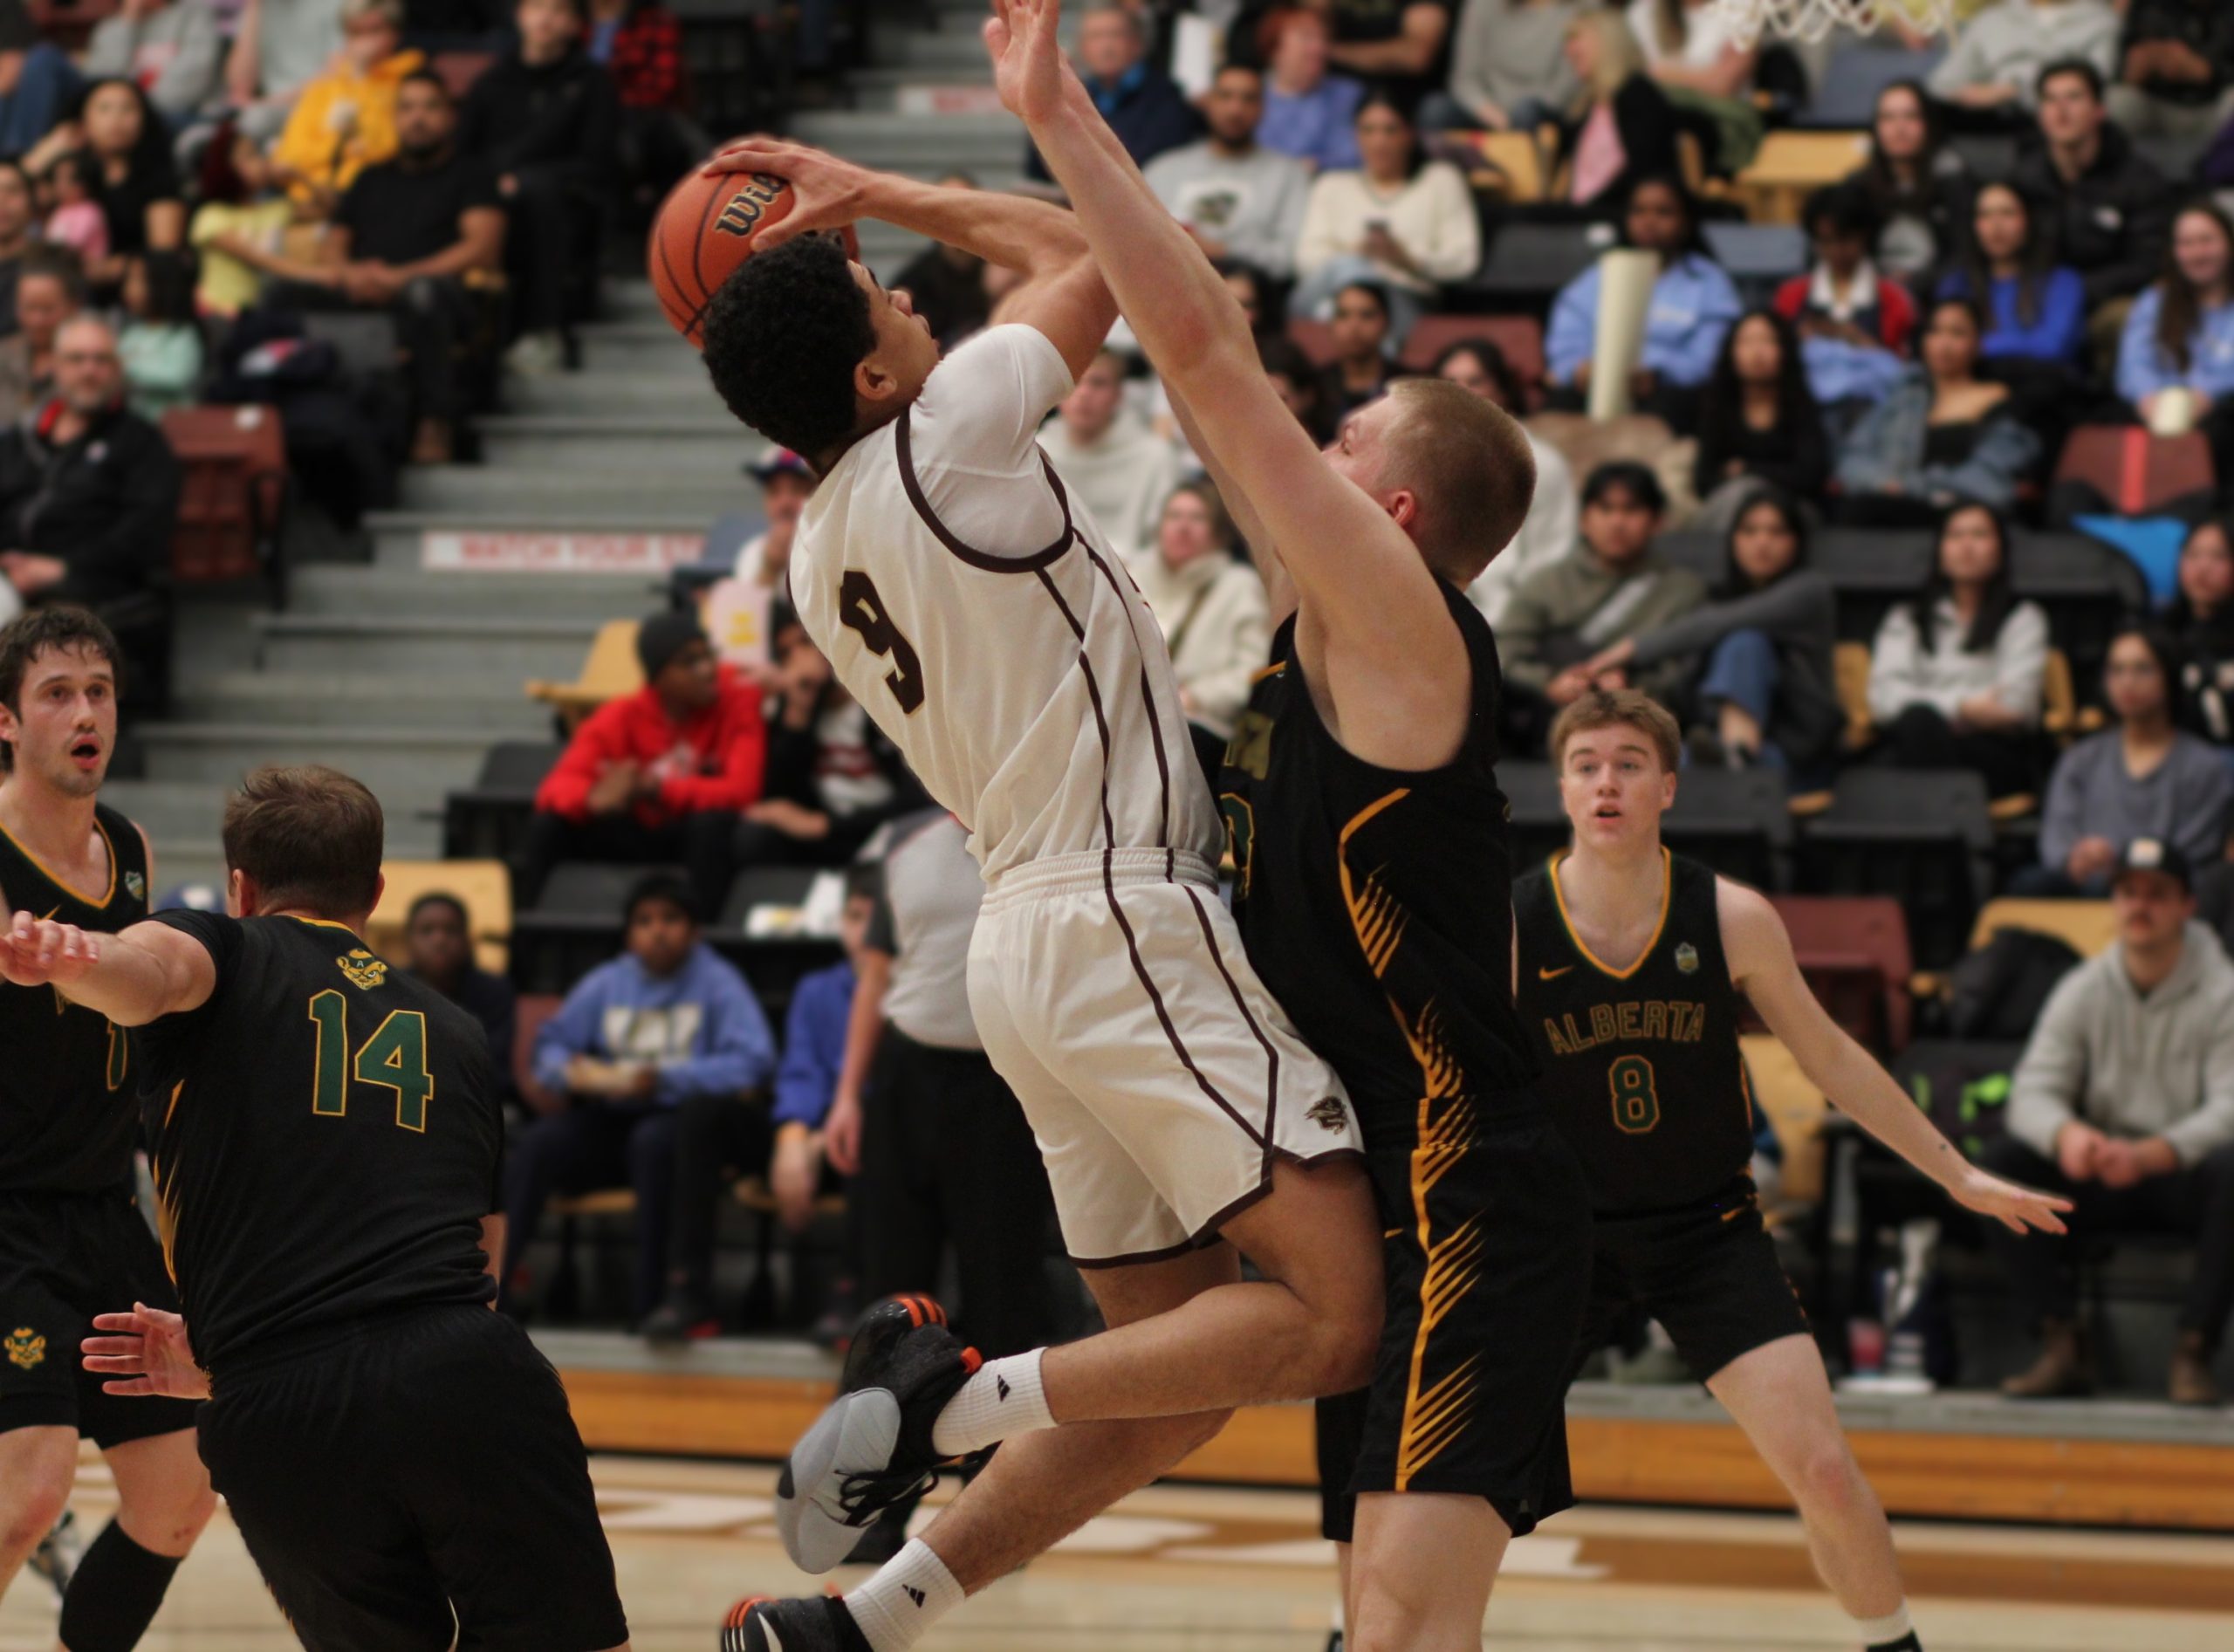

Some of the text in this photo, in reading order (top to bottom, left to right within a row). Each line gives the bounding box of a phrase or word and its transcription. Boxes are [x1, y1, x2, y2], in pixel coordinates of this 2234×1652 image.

[714, 174, 785, 236] Wil
[837, 567, 926, 716] 9
[308, 988, 434, 1133] 14
[1544, 1001, 1704, 1054] ALBERTA
[1608, 1054, 1661, 1134] 8
